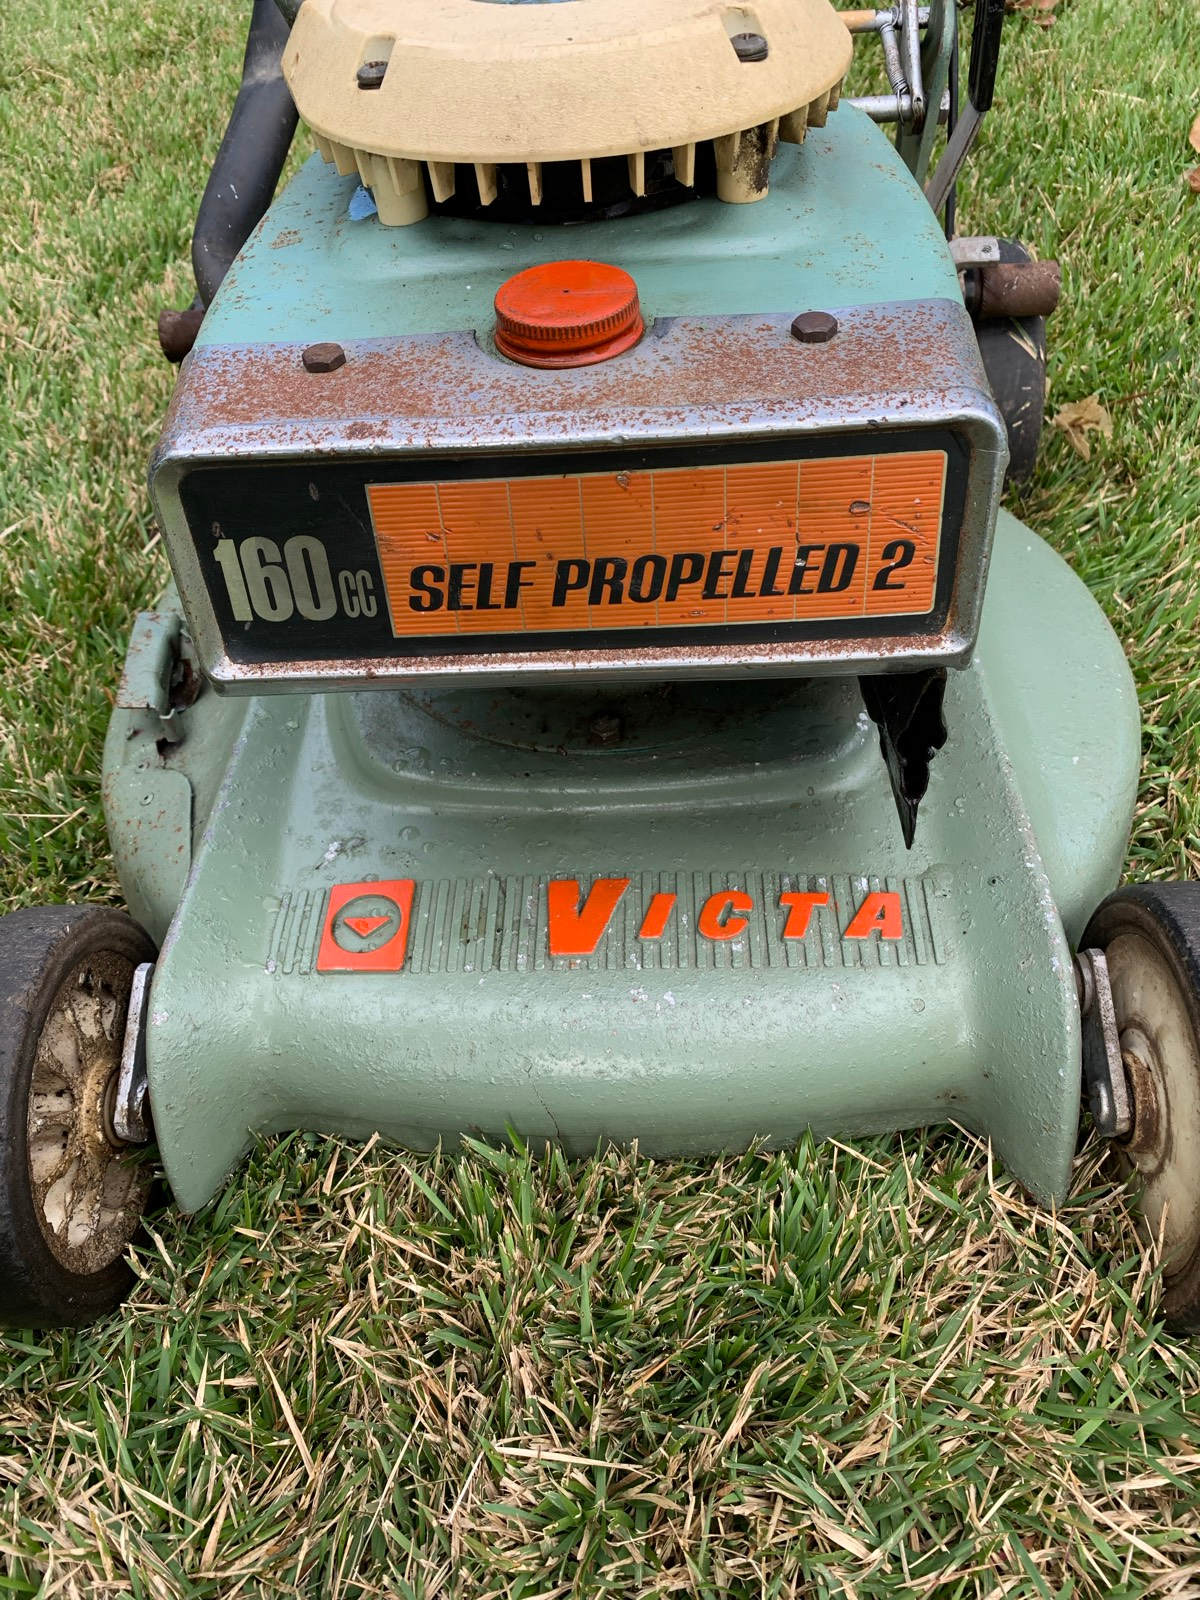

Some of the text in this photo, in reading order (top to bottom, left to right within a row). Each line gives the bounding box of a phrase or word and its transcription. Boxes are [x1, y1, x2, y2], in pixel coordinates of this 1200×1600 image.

[409, 539, 917, 612] SELF PROPELLED 2
[547, 877, 904, 956] VICTA
